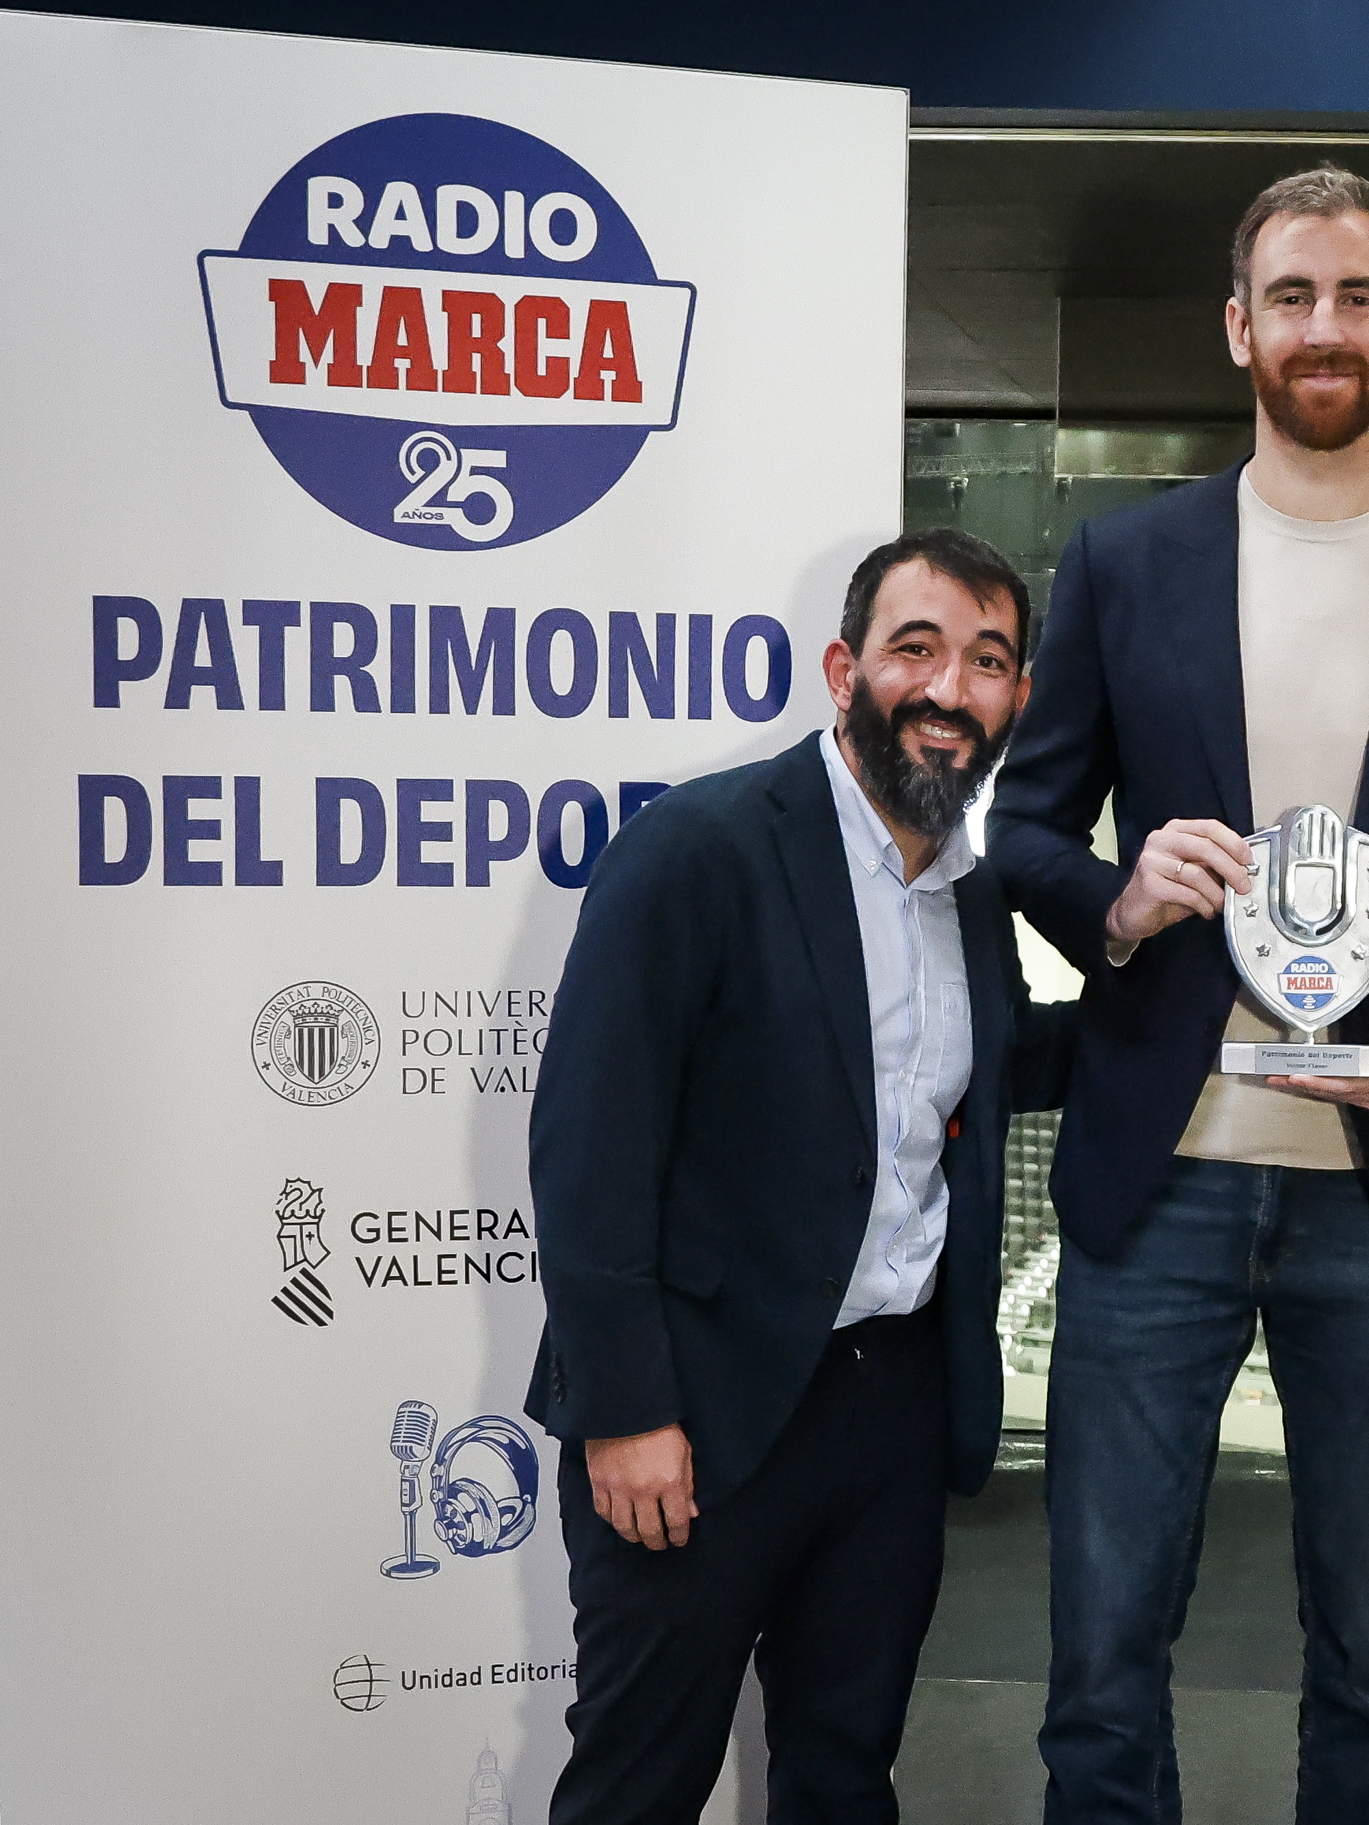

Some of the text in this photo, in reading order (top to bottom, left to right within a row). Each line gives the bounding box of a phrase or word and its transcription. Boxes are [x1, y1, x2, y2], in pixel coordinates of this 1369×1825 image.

[307, 175, 599, 263] RADIO
[268, 277, 644, 403] MARCA
[393, 430, 514, 542] 25
[401, 508, 445, 521] AÑOS
[92, 595, 793, 722] PATRIMONIO
[77, 773, 284, 887] DEL
[1286, 976, 1334, 990] MARCA
[1290, 962, 1330, 974] RADIO
[401, 989, 549, 1018] UNIVER
[281, 1082, 355, 1103] VALENCIA
[401, 1066, 446, 1095] DE
[350, 1208, 538, 1244] GENERA
[355, 1251, 537, 1288] VALENCI
[401, 1659, 577, 1691] Unidad Editoria
